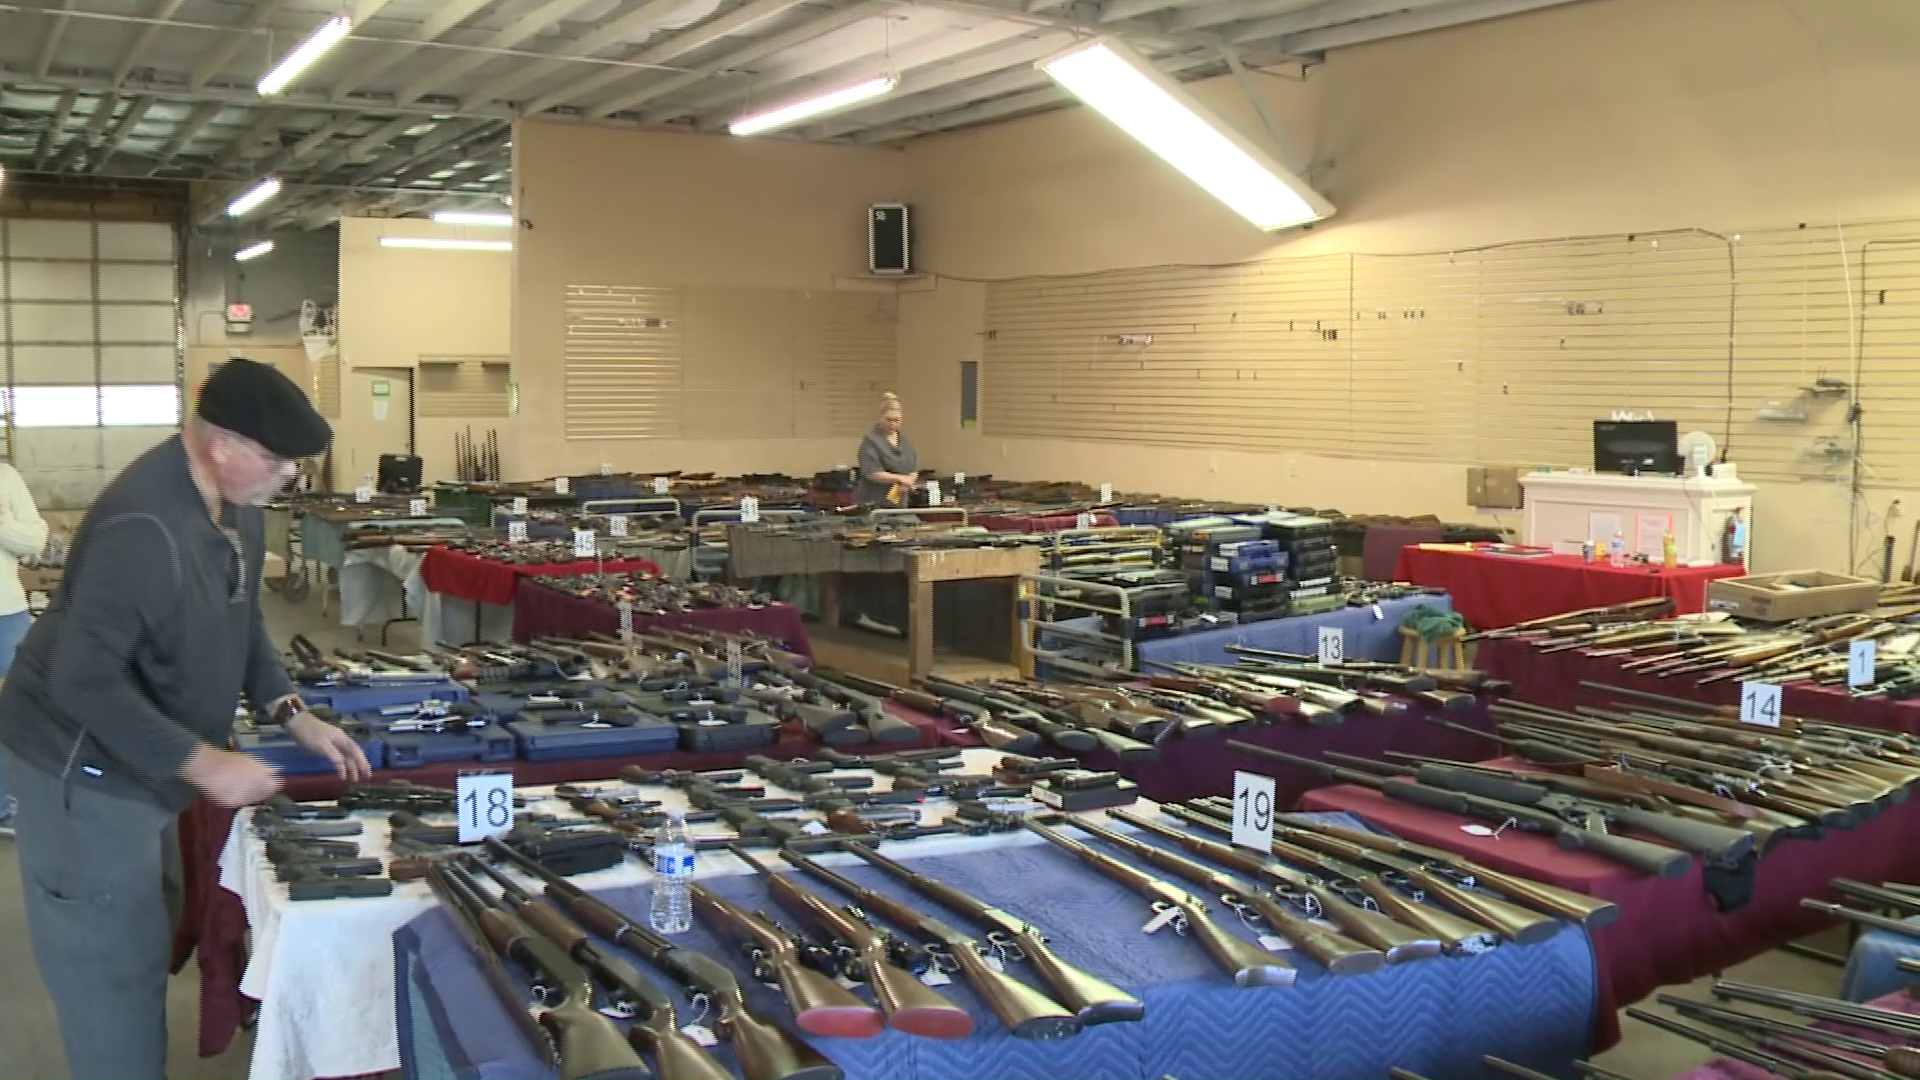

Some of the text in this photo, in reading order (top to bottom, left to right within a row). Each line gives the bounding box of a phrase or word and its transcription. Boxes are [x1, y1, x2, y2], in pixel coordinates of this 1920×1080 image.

[742, 502, 756, 516] 41
[510, 525, 524, 538] 44
[576, 535, 593, 551] 45
[1321, 634, 1341, 660] 13
[1858, 650, 1865, 674] 1
[1746, 691, 1776, 722] 14
[463, 787, 509, 829] 18
[1239, 788, 1270, 831] 19
